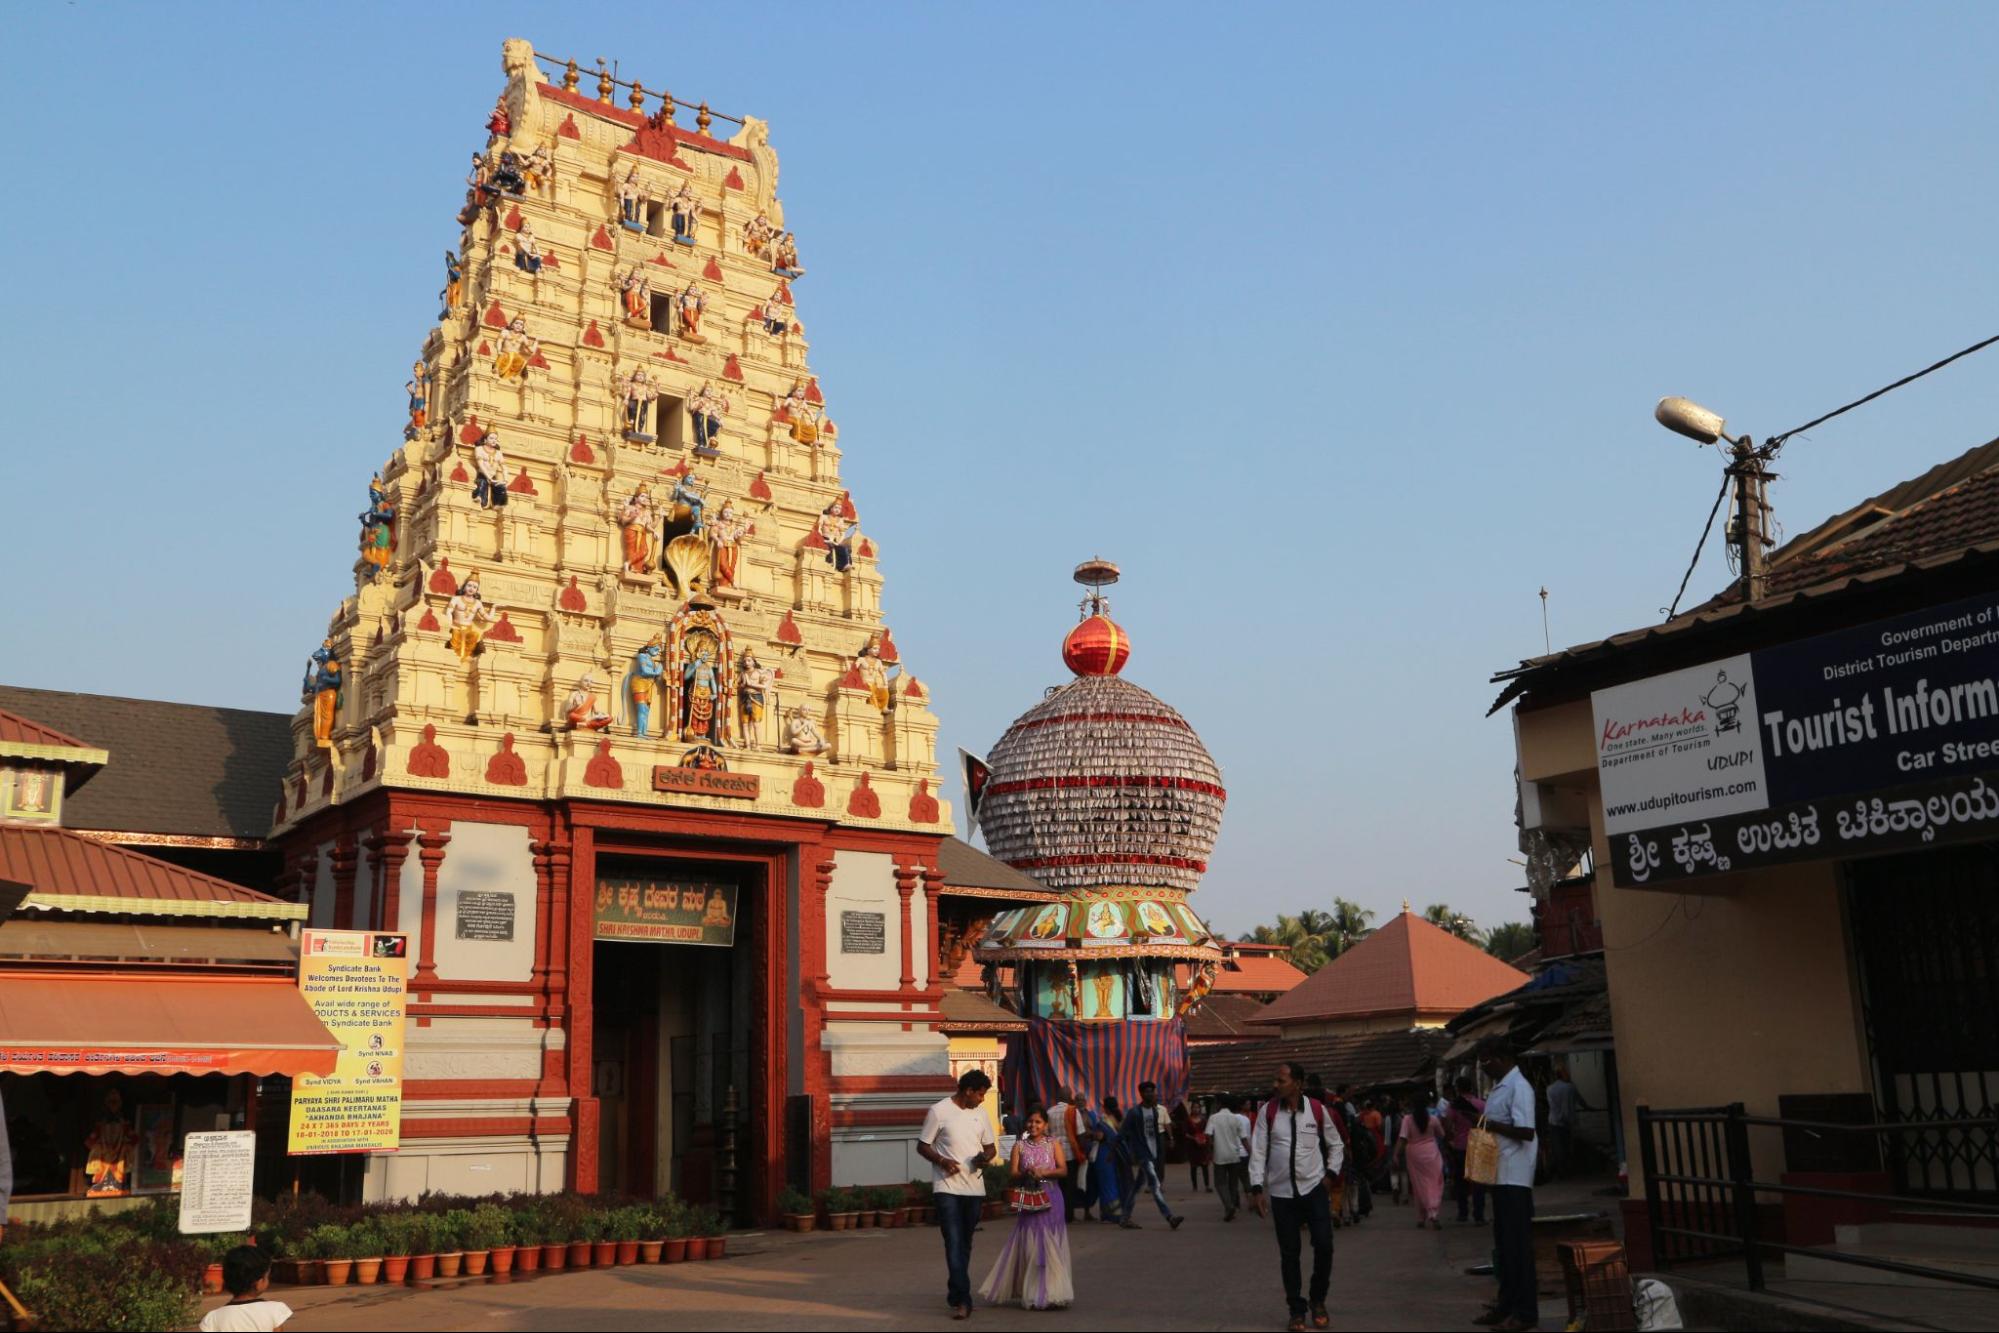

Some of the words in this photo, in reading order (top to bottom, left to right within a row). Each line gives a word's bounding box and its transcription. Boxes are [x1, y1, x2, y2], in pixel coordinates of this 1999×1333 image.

[1881, 614, 1973, 647] Government
[1976, 607, 1993, 624] of
[1823, 658, 1875, 680] District
[1876, 645, 1938, 668] Tourism
[1763, 692, 1878, 758] Tourist
[1883, 678, 1999, 735] Inform
[1600, 707, 1706, 751] Karnataka
[1607, 743, 1623, 752] One
[1625, 738, 1650, 749] state.
[1651, 733, 1674, 744] Many
[1602, 751, 1655, 768] Department
[1658, 746, 1669, 756] of
[1672, 739, 1711, 753] Tourism
[1707, 750, 1754, 771] UDUPI
[1897, 750, 1936, 772] Car
[1607, 780, 1757, 818] www.udupitourism.com
[1629, 834, 1660, 882] ಶ್ರೀ
[1672, 824, 1731, 873] ಕೃಷ್ಣ
[1737, 805, 1821, 854] ಉಚಿತ
[1836, 777, 1999, 842] ಚಿಕಿತ್ಸಾಲಯ
[596, 881, 614, 913] ಶ್ರೀ
[599, 923, 616, 934] SHRI
[618, 924, 649, 936] KRISHNA
[307, 974, 343, 982] Welcomes
[345, 975, 376, 983] Devotees
[378, 975, 386, 983] To
[388, 975, 400, 983] The
[328, 964, 362, 973] Syndicate
[304, 984, 326, 992] Abode
[354, 985, 380, 993] Krishna
[382, 986, 402, 994] Udupi
[357, 1001, 380, 1009] range
[359, 1009, 401, 1017] SERVICES
[331, 1019, 370, 1030] Syndicate
[372, 1019, 392, 1027] Bank
[294, 1096, 322, 1105] PARYAYA
[324, 1096, 340, 1104] SHRI
[341, 1096, 375, 1104] PALIMARU
[376, 1095, 398, 1103] MATHA
[325, 1121, 339, 1129] 365
